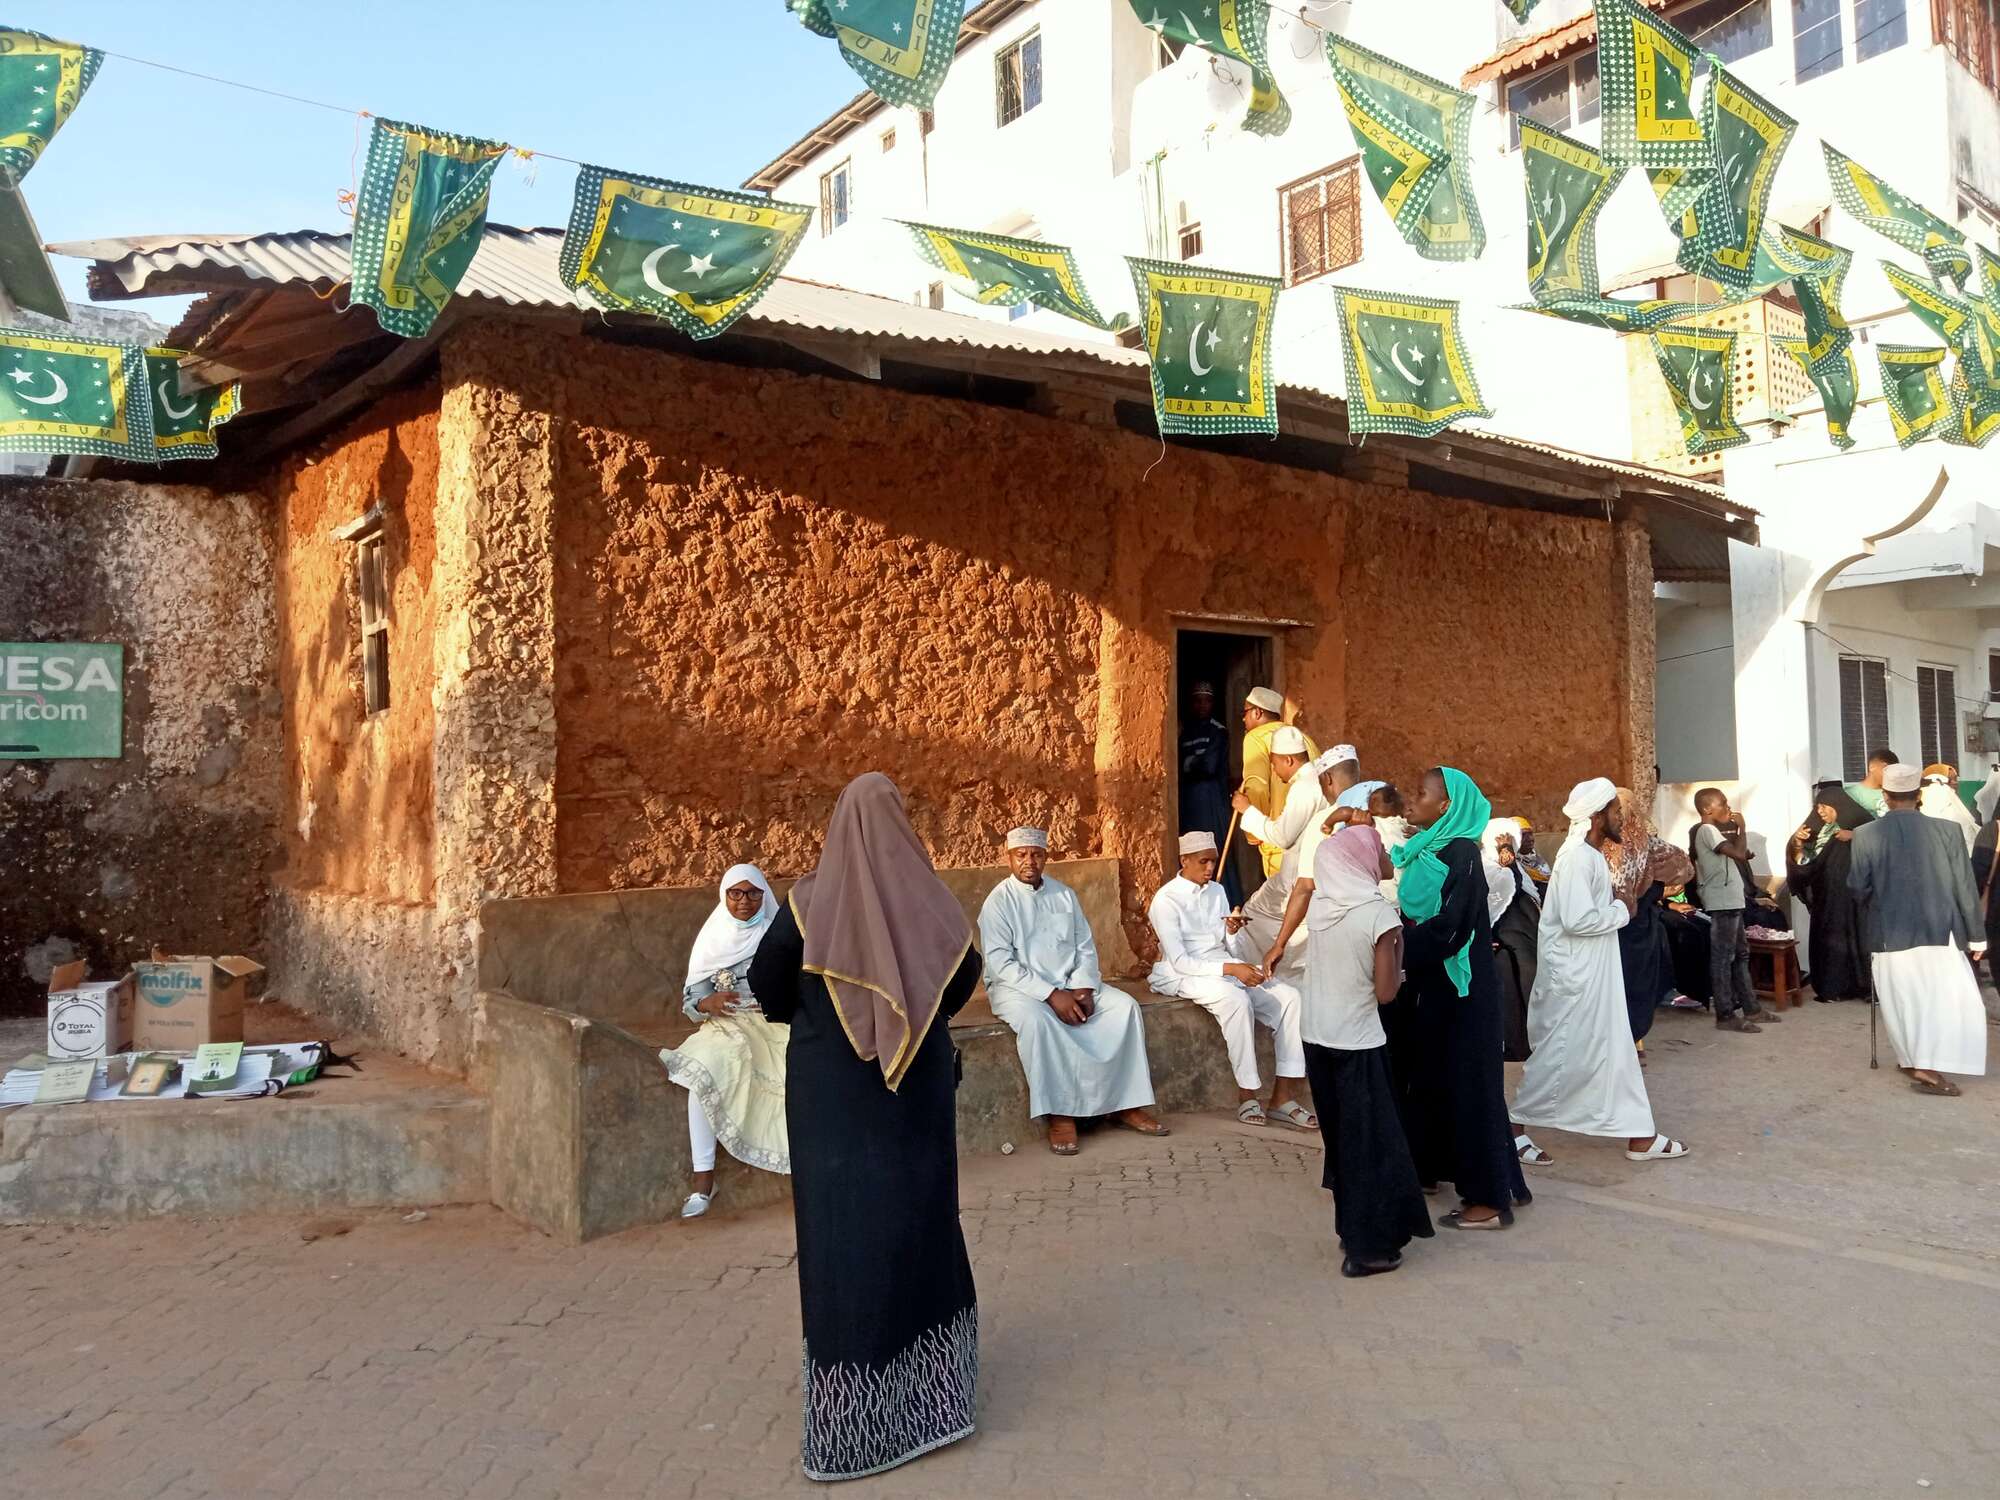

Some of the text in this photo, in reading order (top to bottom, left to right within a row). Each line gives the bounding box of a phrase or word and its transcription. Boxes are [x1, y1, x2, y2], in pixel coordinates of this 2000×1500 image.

[1637, 32, 1652, 117] ULIDI
[1343, 102, 1415, 162] BARAK
[389, 153, 416, 271] MAULIDI
[628, 187, 778, 226] MAULIDI
[1164, 281, 1255, 298] MAULIDI
[1149, 291, 1160, 348] MAUL
[1363, 303, 1438, 321] MAULIDI
[1252, 306, 1267, 402] MUBARAK
[1166, 400, 1248, 413] UBARAK
[0, 656, 118, 692] ESA
[0, 699, 88, 720] ricom
[142, 971, 203, 990] molfix
